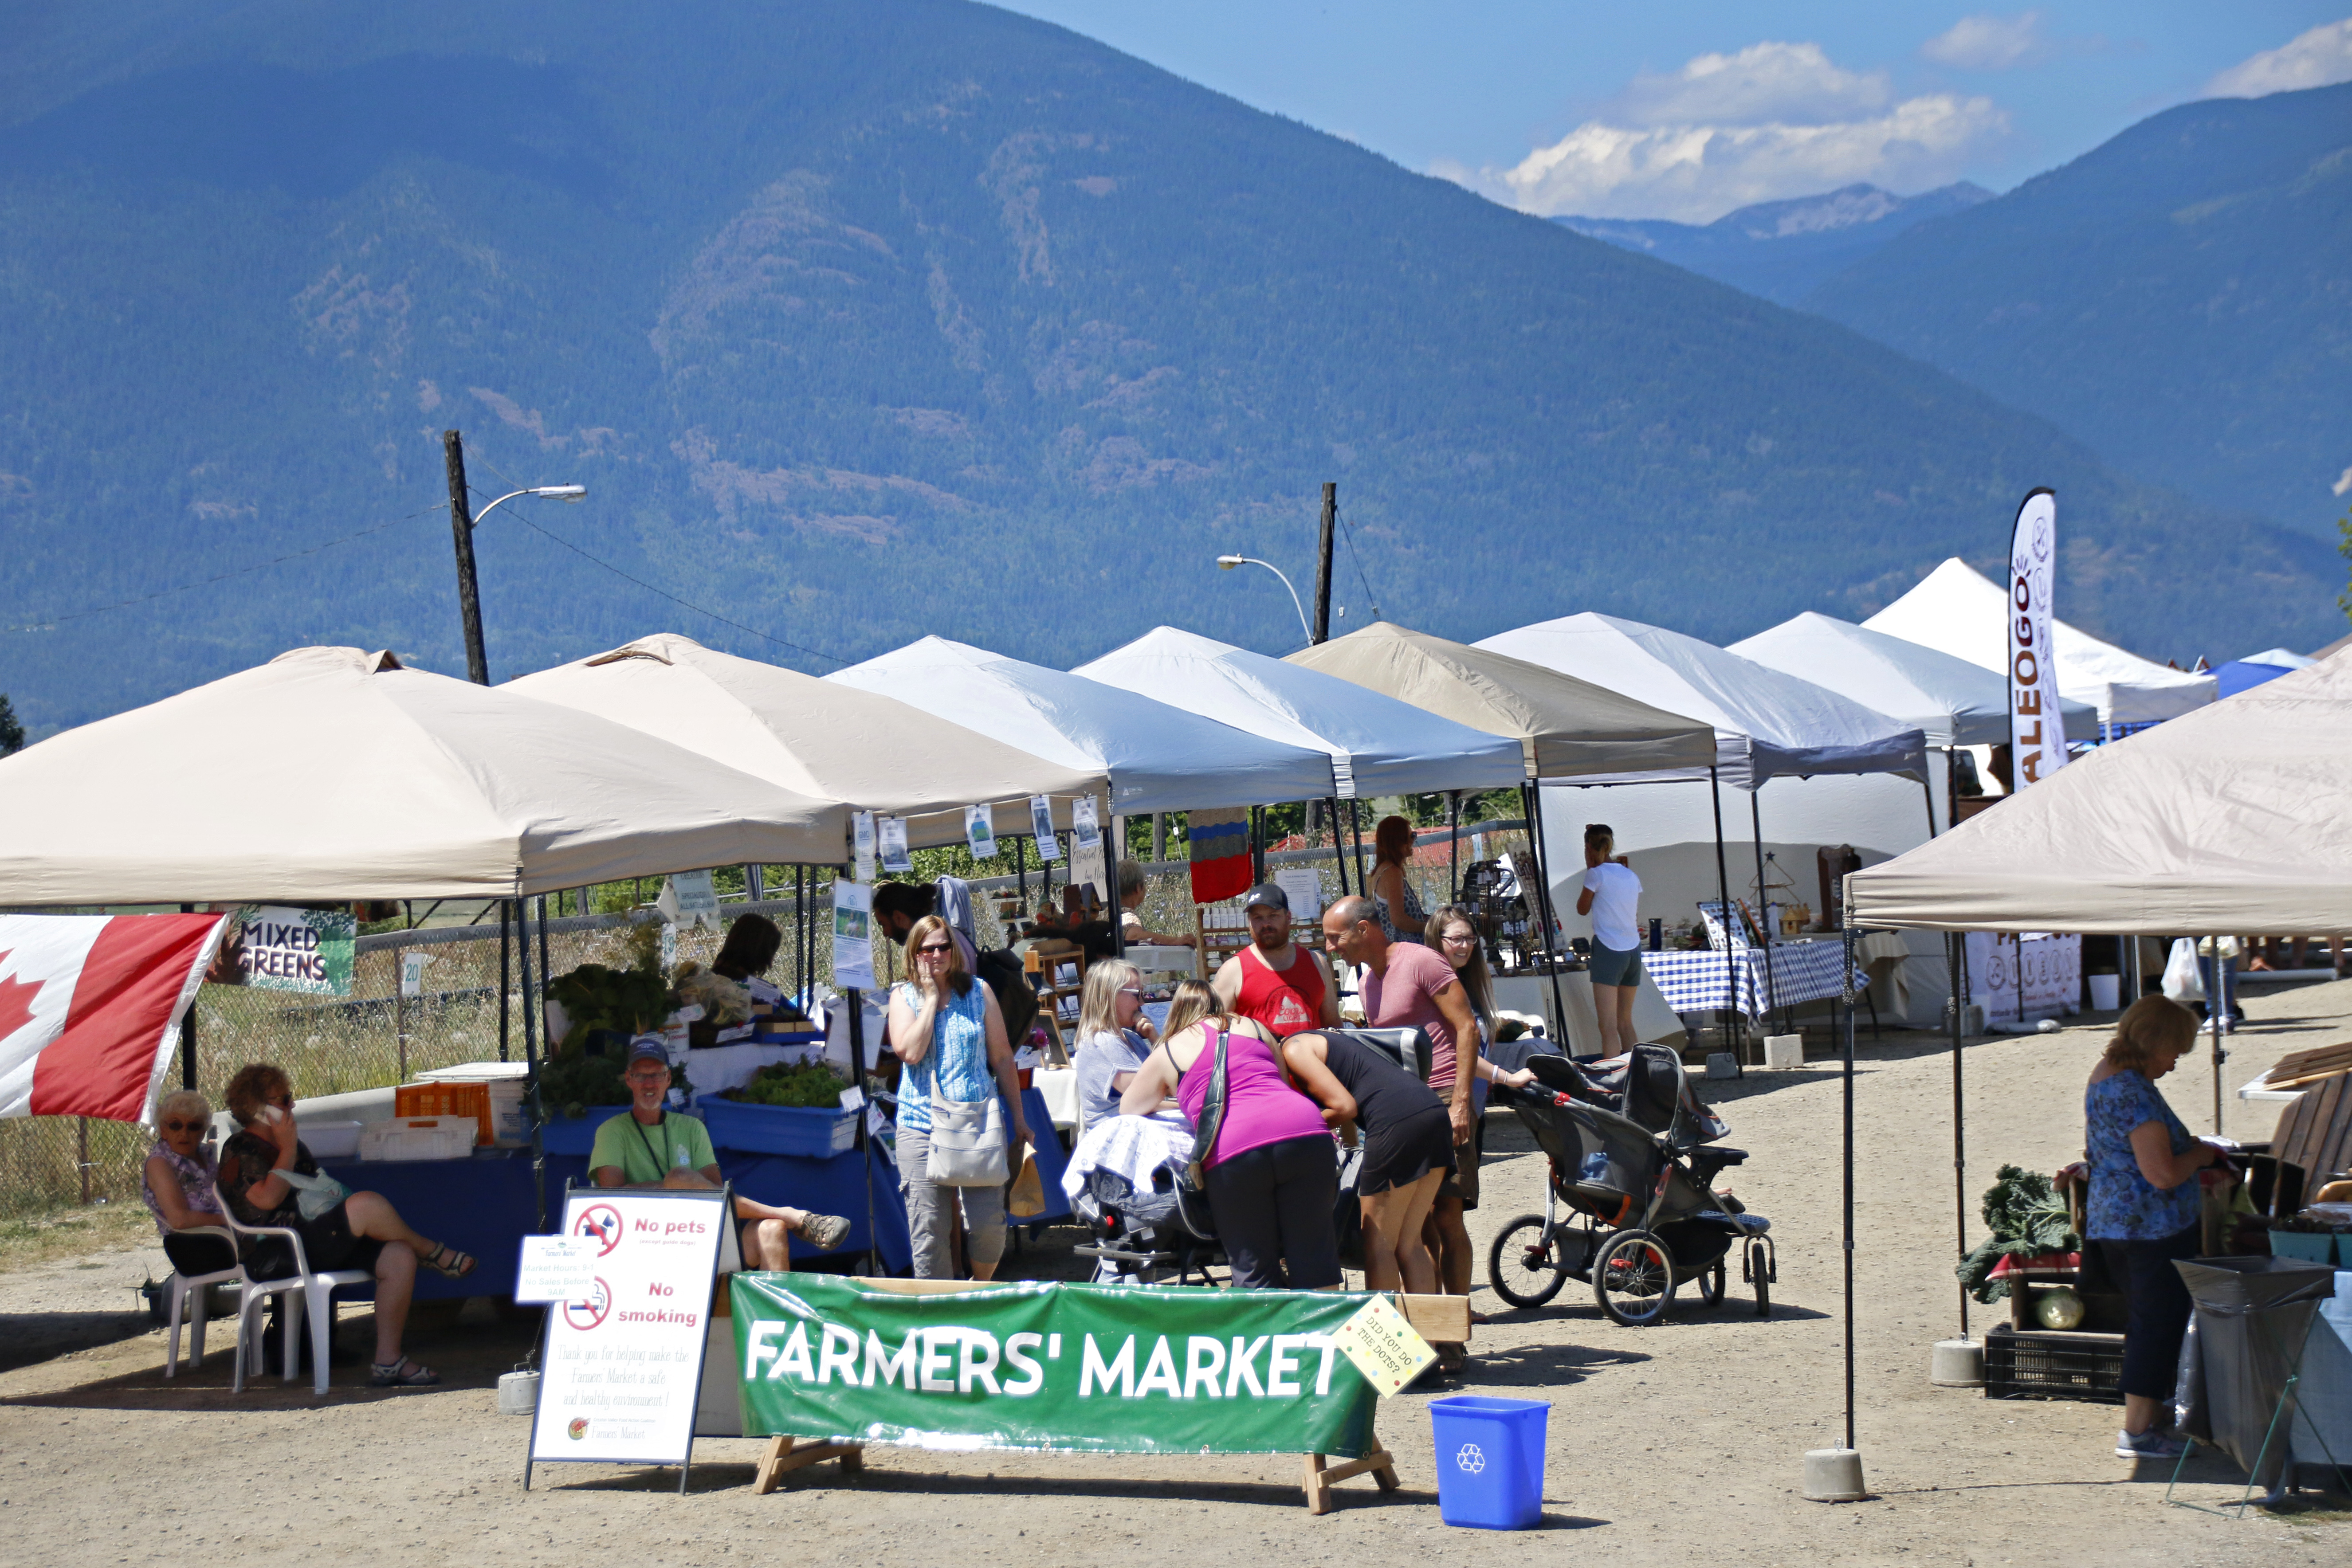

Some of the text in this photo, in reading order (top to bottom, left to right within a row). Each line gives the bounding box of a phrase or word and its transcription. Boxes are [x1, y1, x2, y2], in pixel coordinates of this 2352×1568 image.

[2014, 575, 2042, 788] ALEOGO
[1072, 843, 1097, 864] Essential
[240, 921, 320, 952] MIXED
[238, 947, 327, 981] GREENS
[405, 963, 418, 981] 20
[1279, 1004, 1304, 1016] Coors
[635, 1218, 706, 1236] No pets
[648, 1282, 674, 1297] No
[618, 1309, 698, 1328] smoking
[1357, 1328, 1401, 1373] THE DOTS?
[1366, 1316, 1413, 1366] DID YOU DO
[558, 1345, 689, 1366] Thank you for helping make the
[746, 1319, 1336, 1398] FARMERS' MARKET
[571, 1367, 666, 1384] Farmers' Market a safe
[563, 1390, 578, 1405] and
[580, 1390, 610, 1410] healthy
[613, 1394, 663, 1406] environment
[591, 1425, 646, 1439] Farmers' Market
